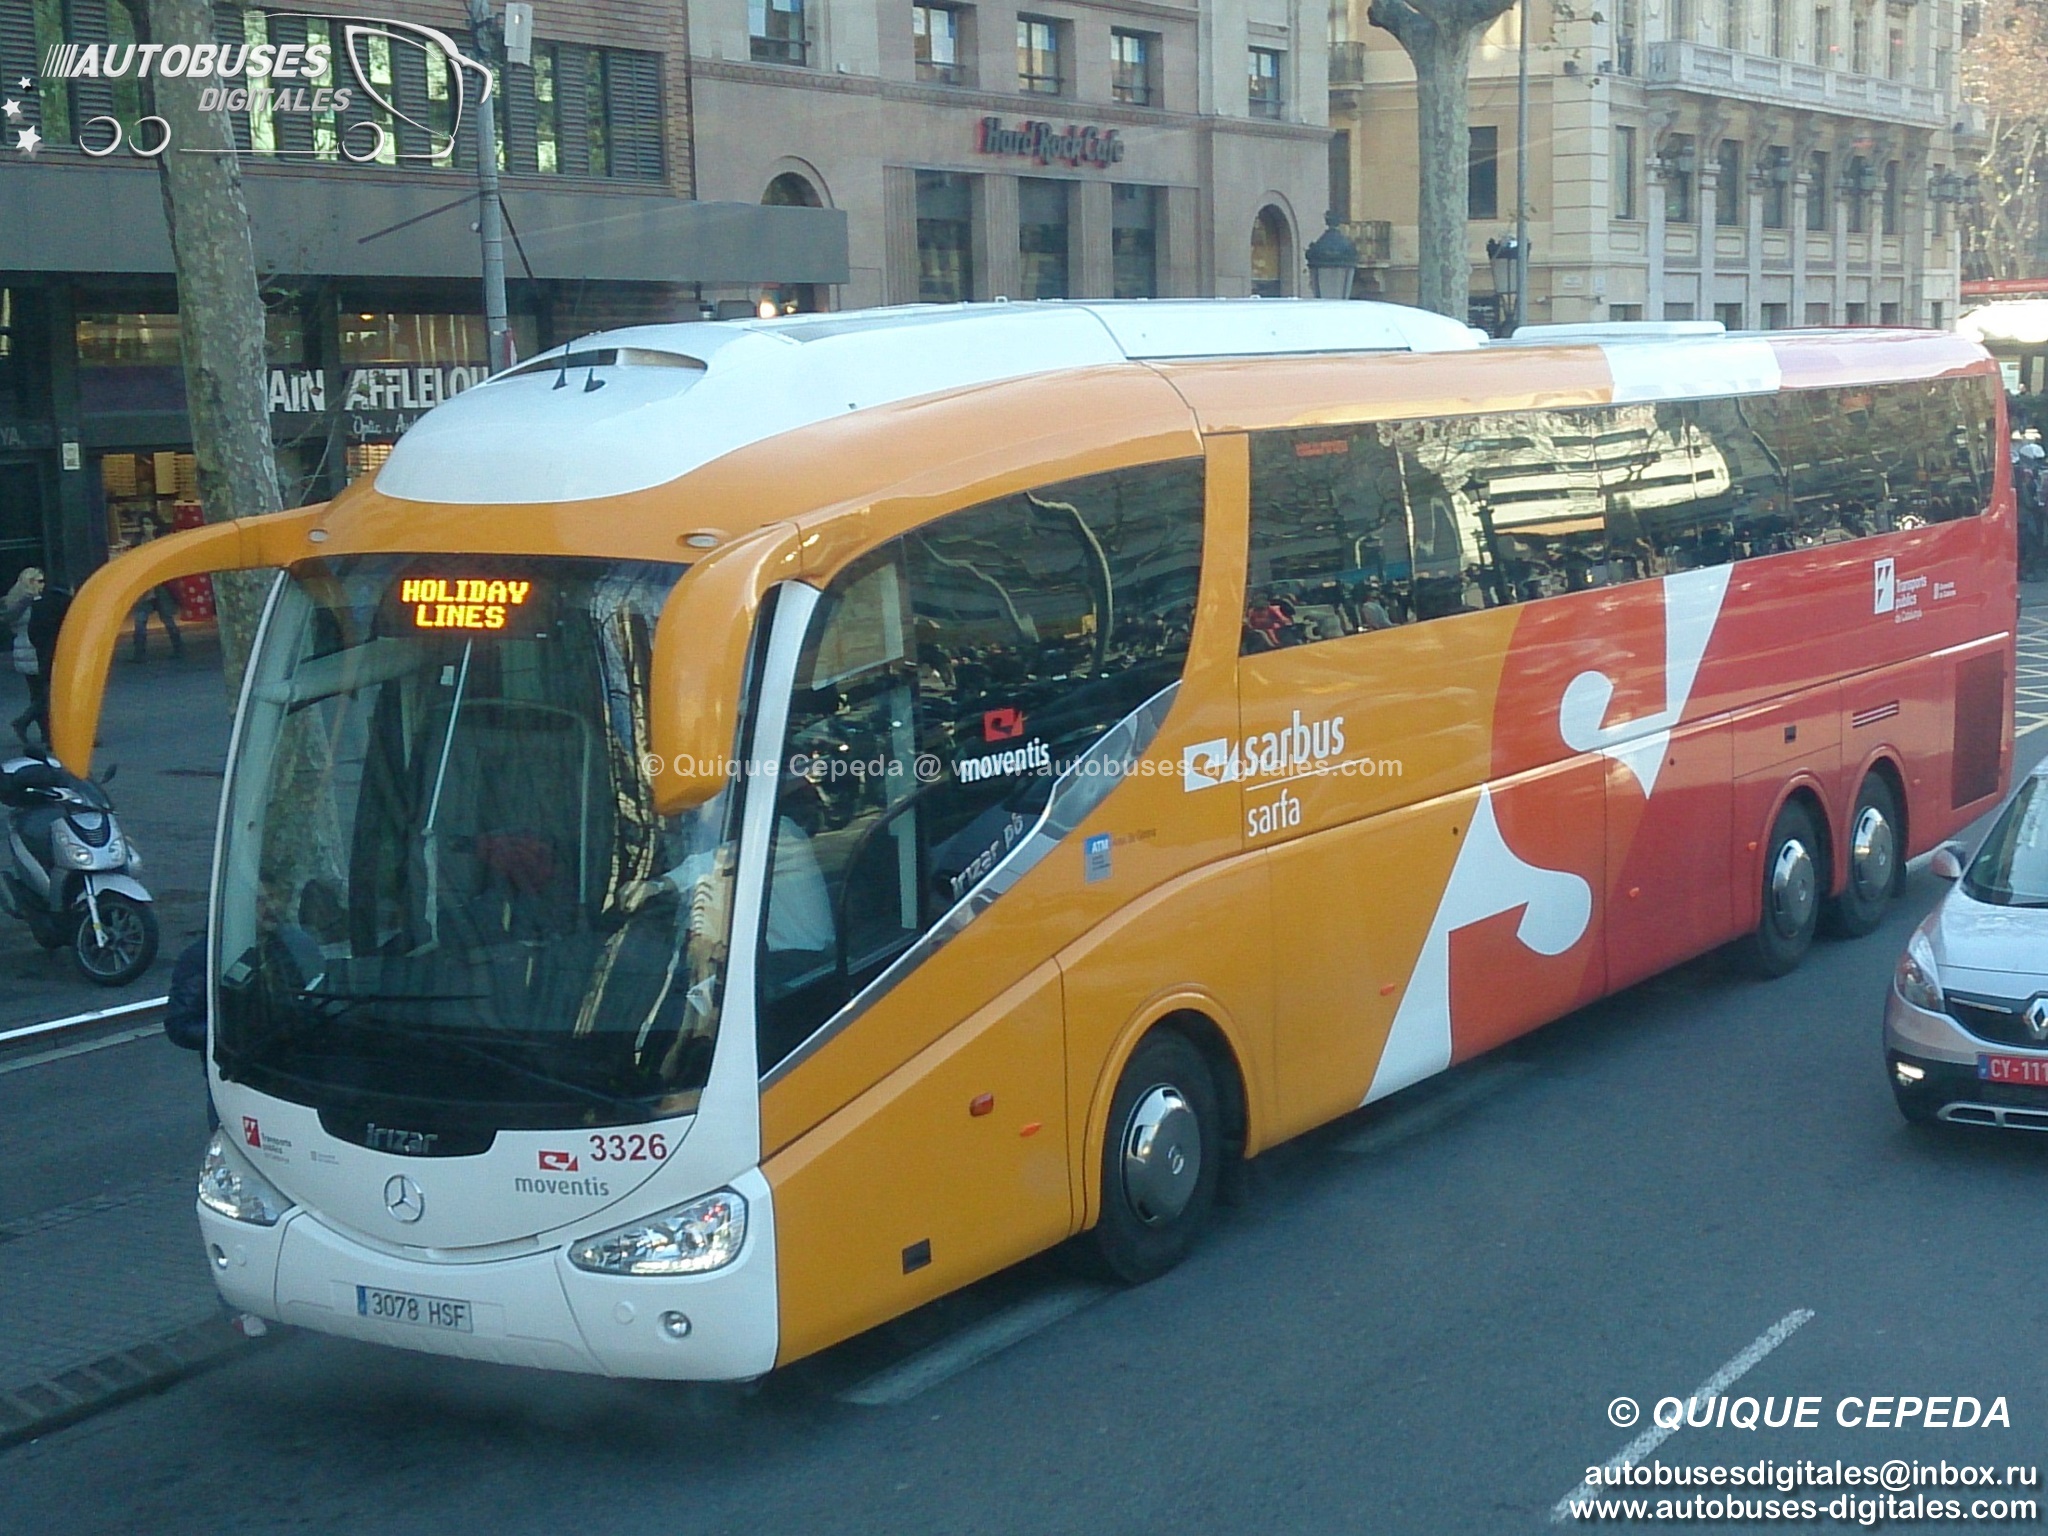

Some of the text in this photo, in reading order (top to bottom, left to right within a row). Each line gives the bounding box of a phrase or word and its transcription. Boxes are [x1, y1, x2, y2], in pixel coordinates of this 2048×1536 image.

[975, 116, 1125, 168] Hard Rock Cafe
[269, 369, 326, 412] AIN
[402, 579, 530, 604] HOLIDAY
[416, 604, 506, 628] LINES
[1244, 709, 1345, 777] sarbus
[959, 737, 1050, 784] moventis
[1247, 788, 1300, 838] sarfa
[1091, 838, 1109, 854] ATM
[366, 1122, 439, 1155] irizar
[590, 1133, 668, 1162] 3326
[515, 1176, 610, 1197] moventis
[372, 1292, 465, 1328] 3078 HSF
